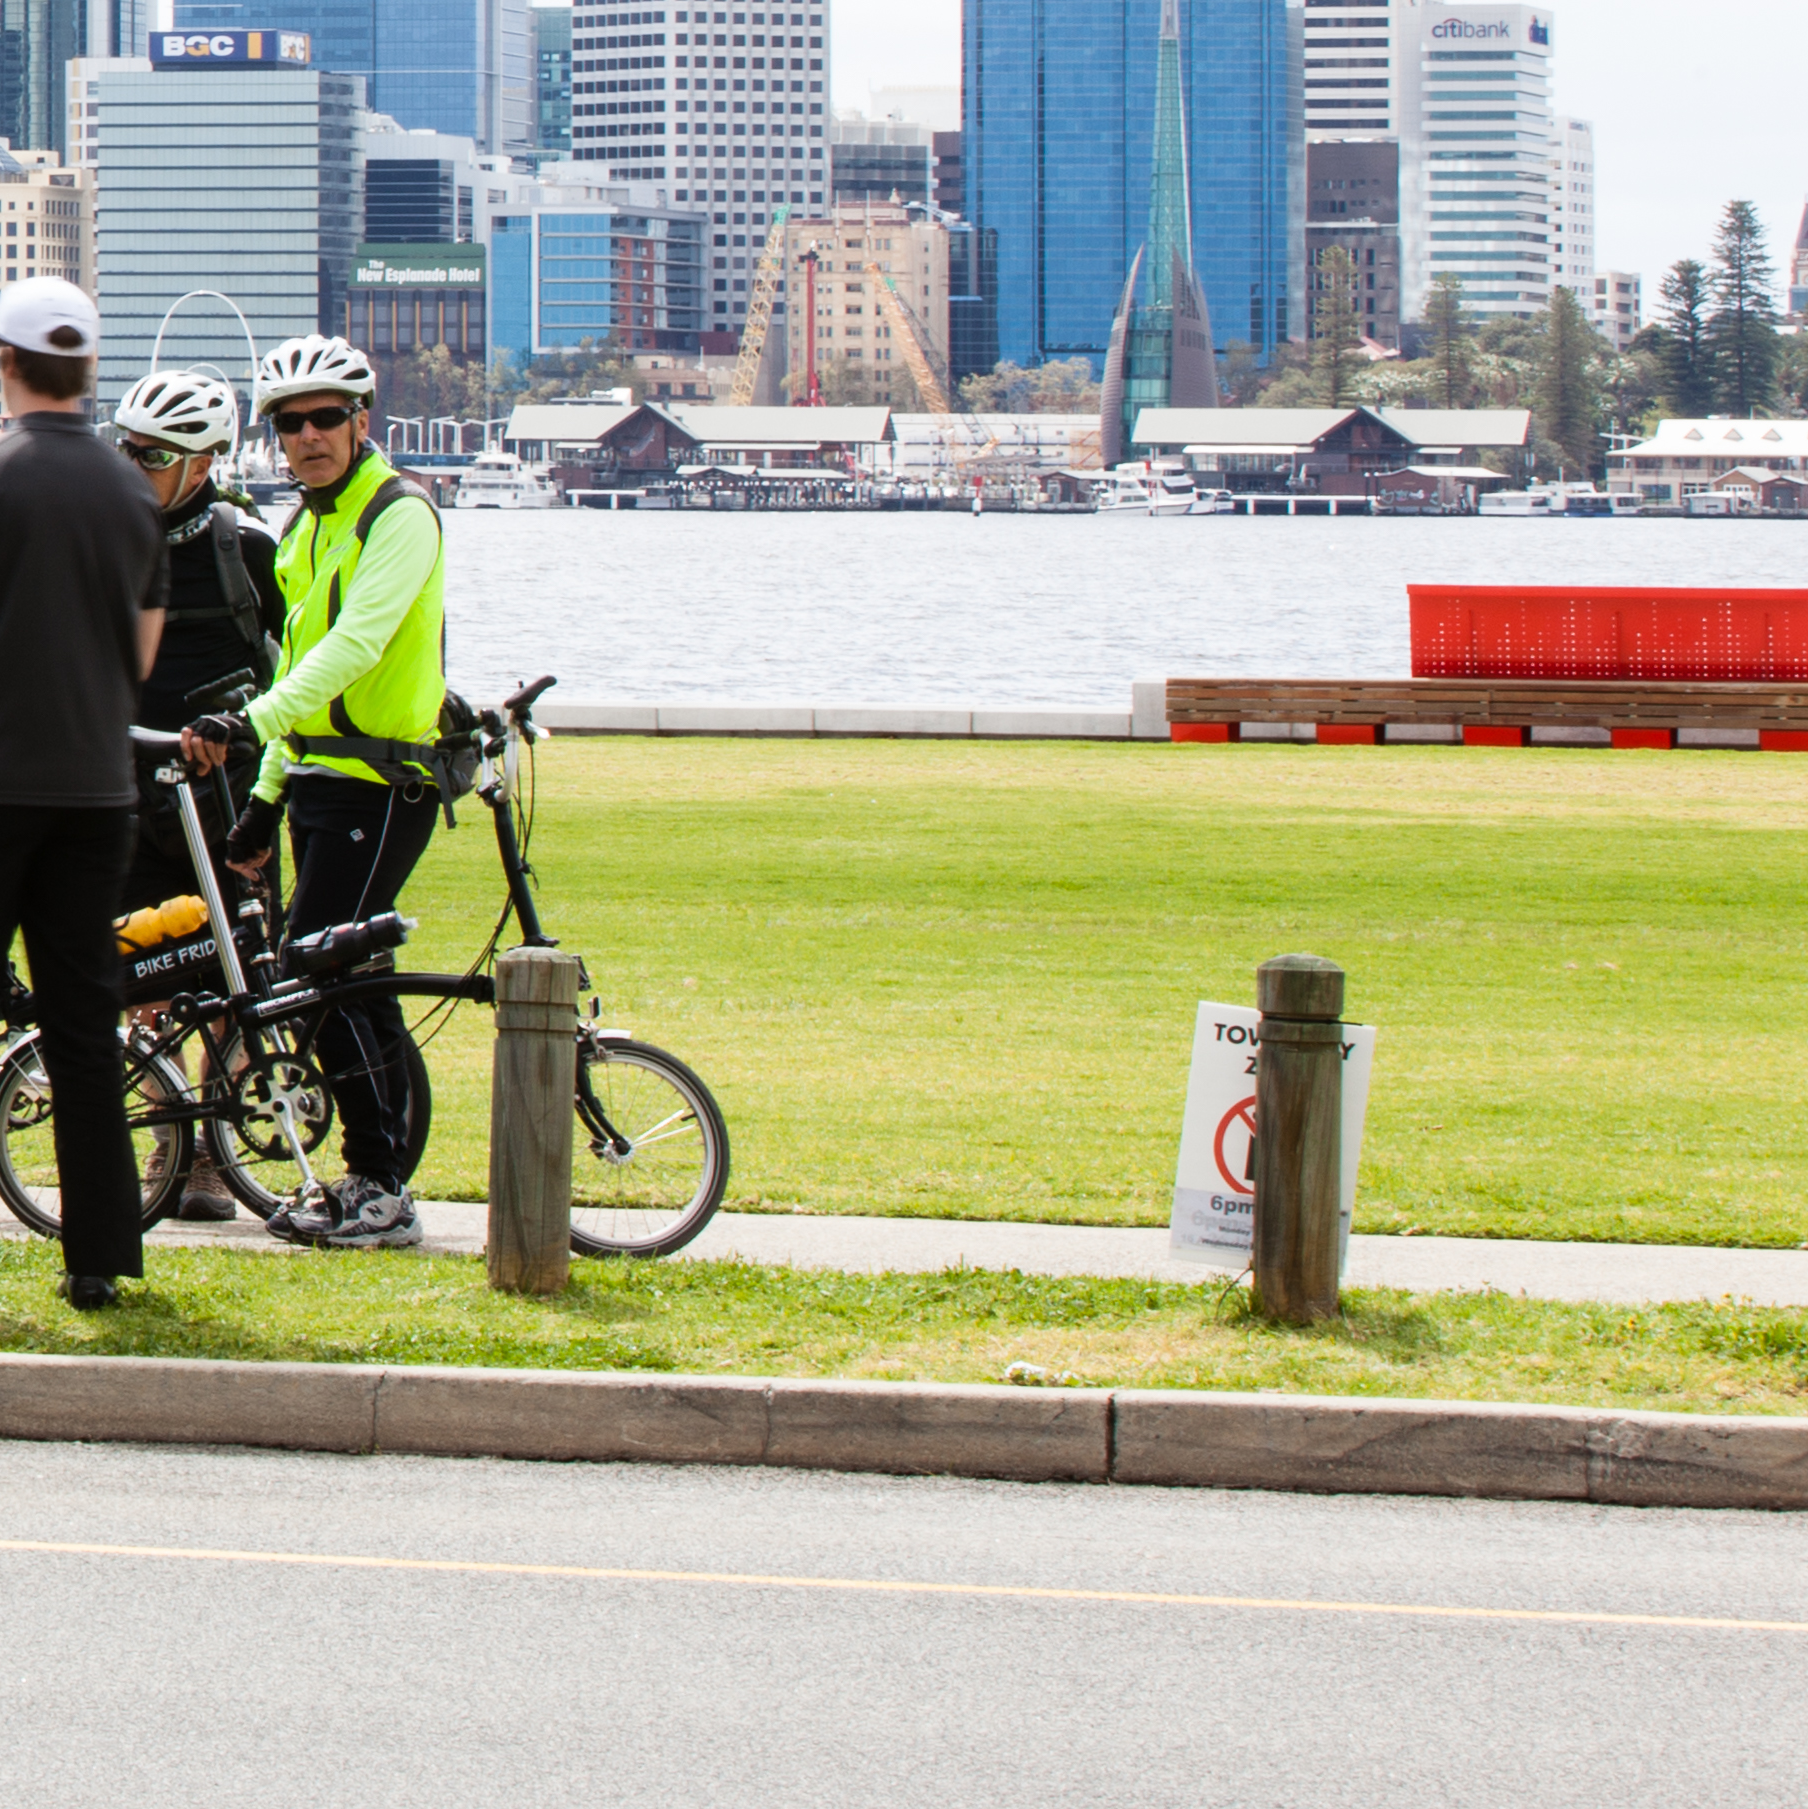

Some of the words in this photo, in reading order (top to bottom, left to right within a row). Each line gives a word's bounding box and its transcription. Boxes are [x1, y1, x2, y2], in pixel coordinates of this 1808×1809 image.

[1431, 17, 1510, 39] citibank
[163, 35, 235, 57] BGC
[357, 268, 383, 282] New
[385, 267, 447, 285] Esplanade
[449, 267, 481, 282] Hotel
[134, 954, 176, 979] BIKE
[177, 939, 220, 965] FRID
